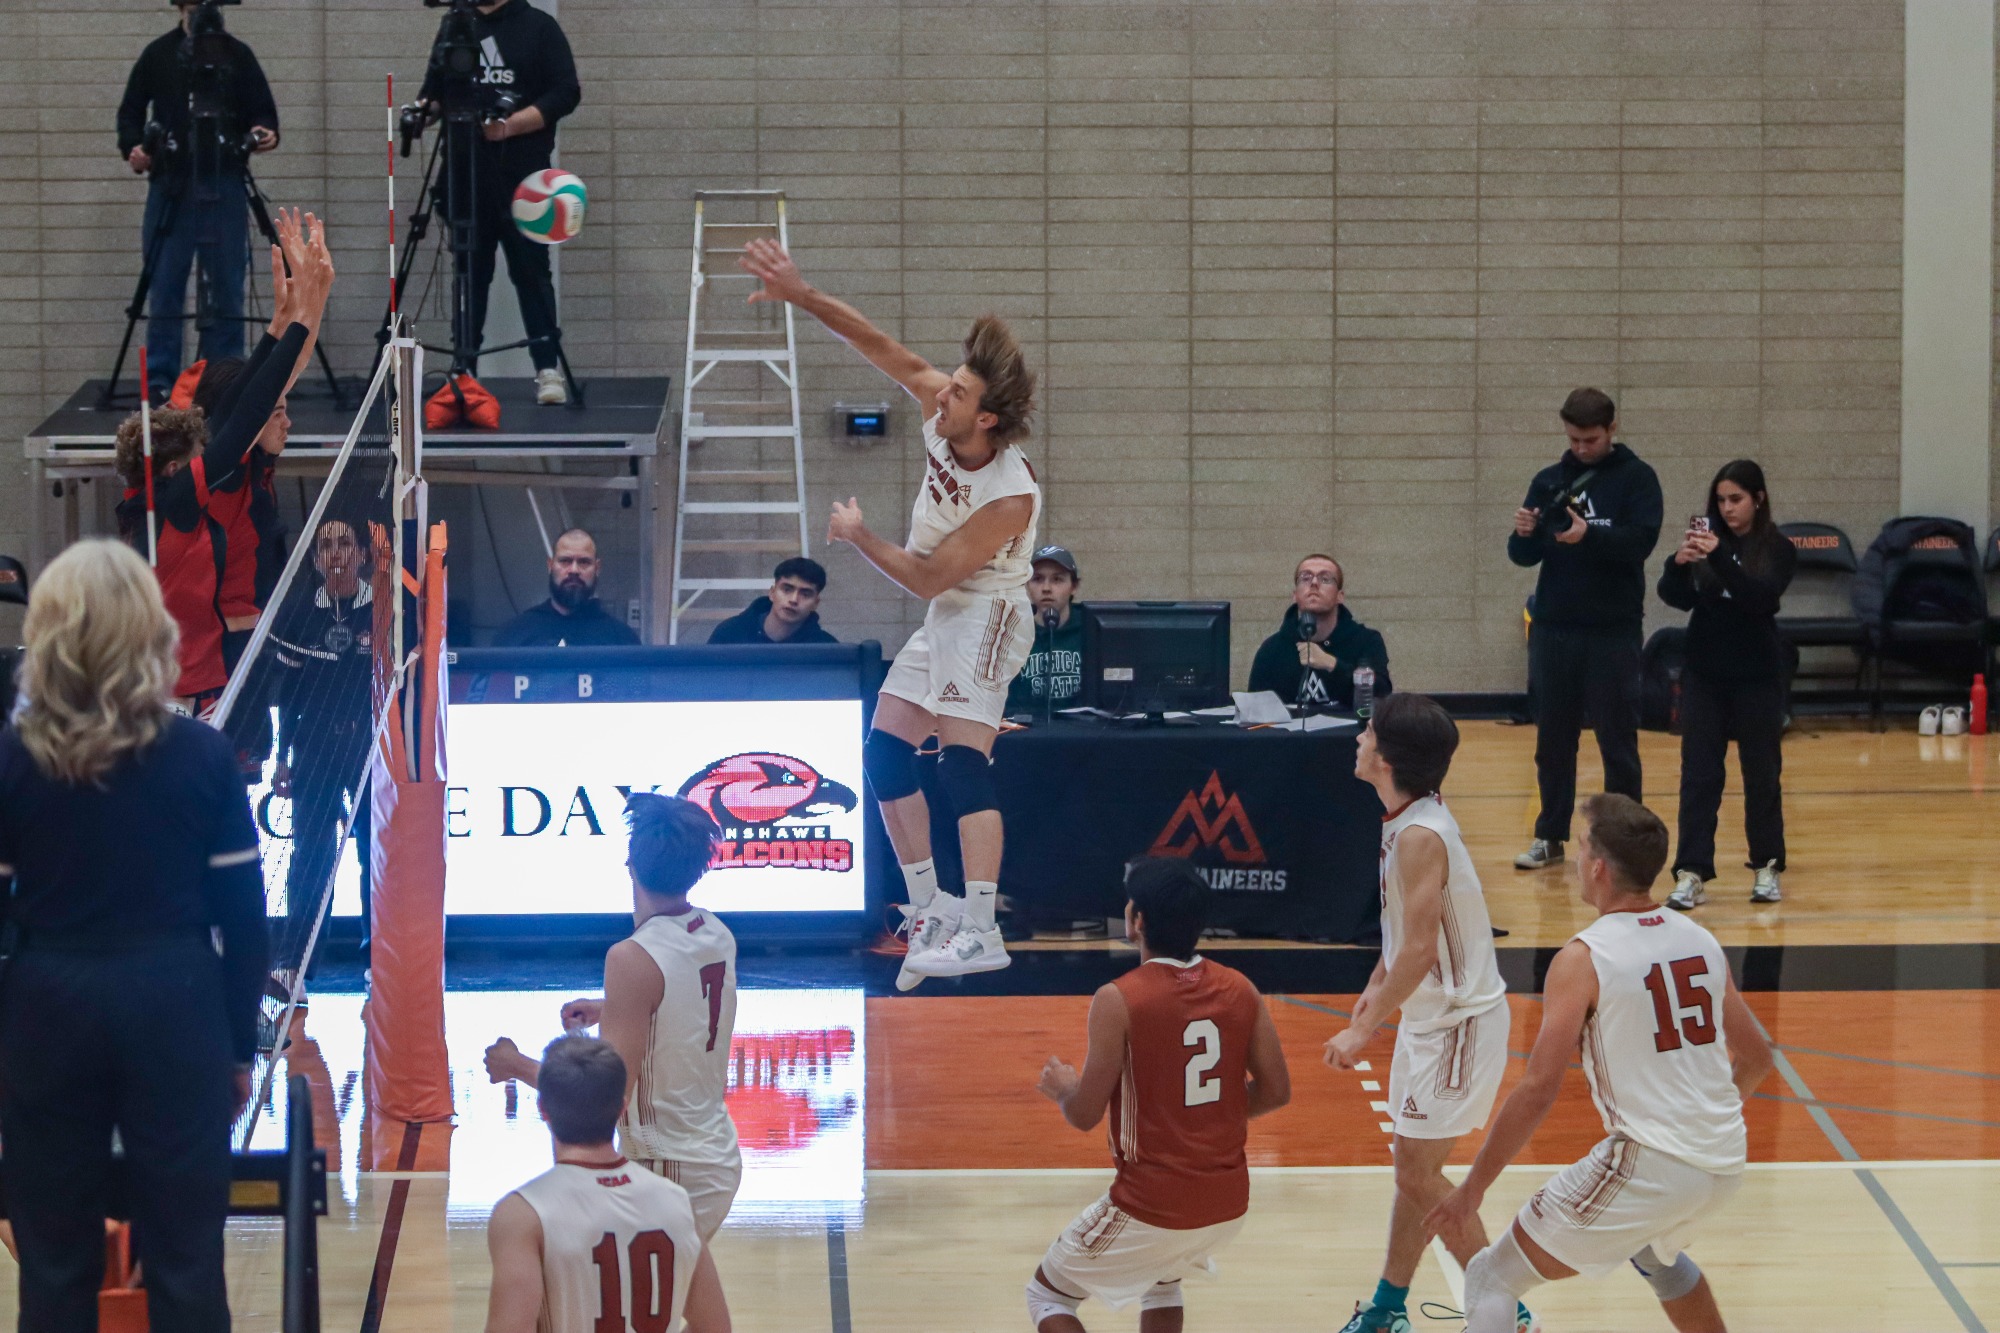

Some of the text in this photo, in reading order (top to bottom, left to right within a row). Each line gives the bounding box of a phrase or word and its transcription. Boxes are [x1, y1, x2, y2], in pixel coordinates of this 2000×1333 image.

[480, 66, 514, 84] das
[1021, 651, 1081, 677] MICHIGA
[514, 674, 593, 699] P B
[725, 827, 826, 839] NSHAWE
[711, 839, 853, 872] LCONS
[699, 960, 726, 1053] 7
[1643, 955, 1716, 1053] 15
[1182, 1018, 1222, 1107] 2
[592, 1228, 675, 1333] 10
